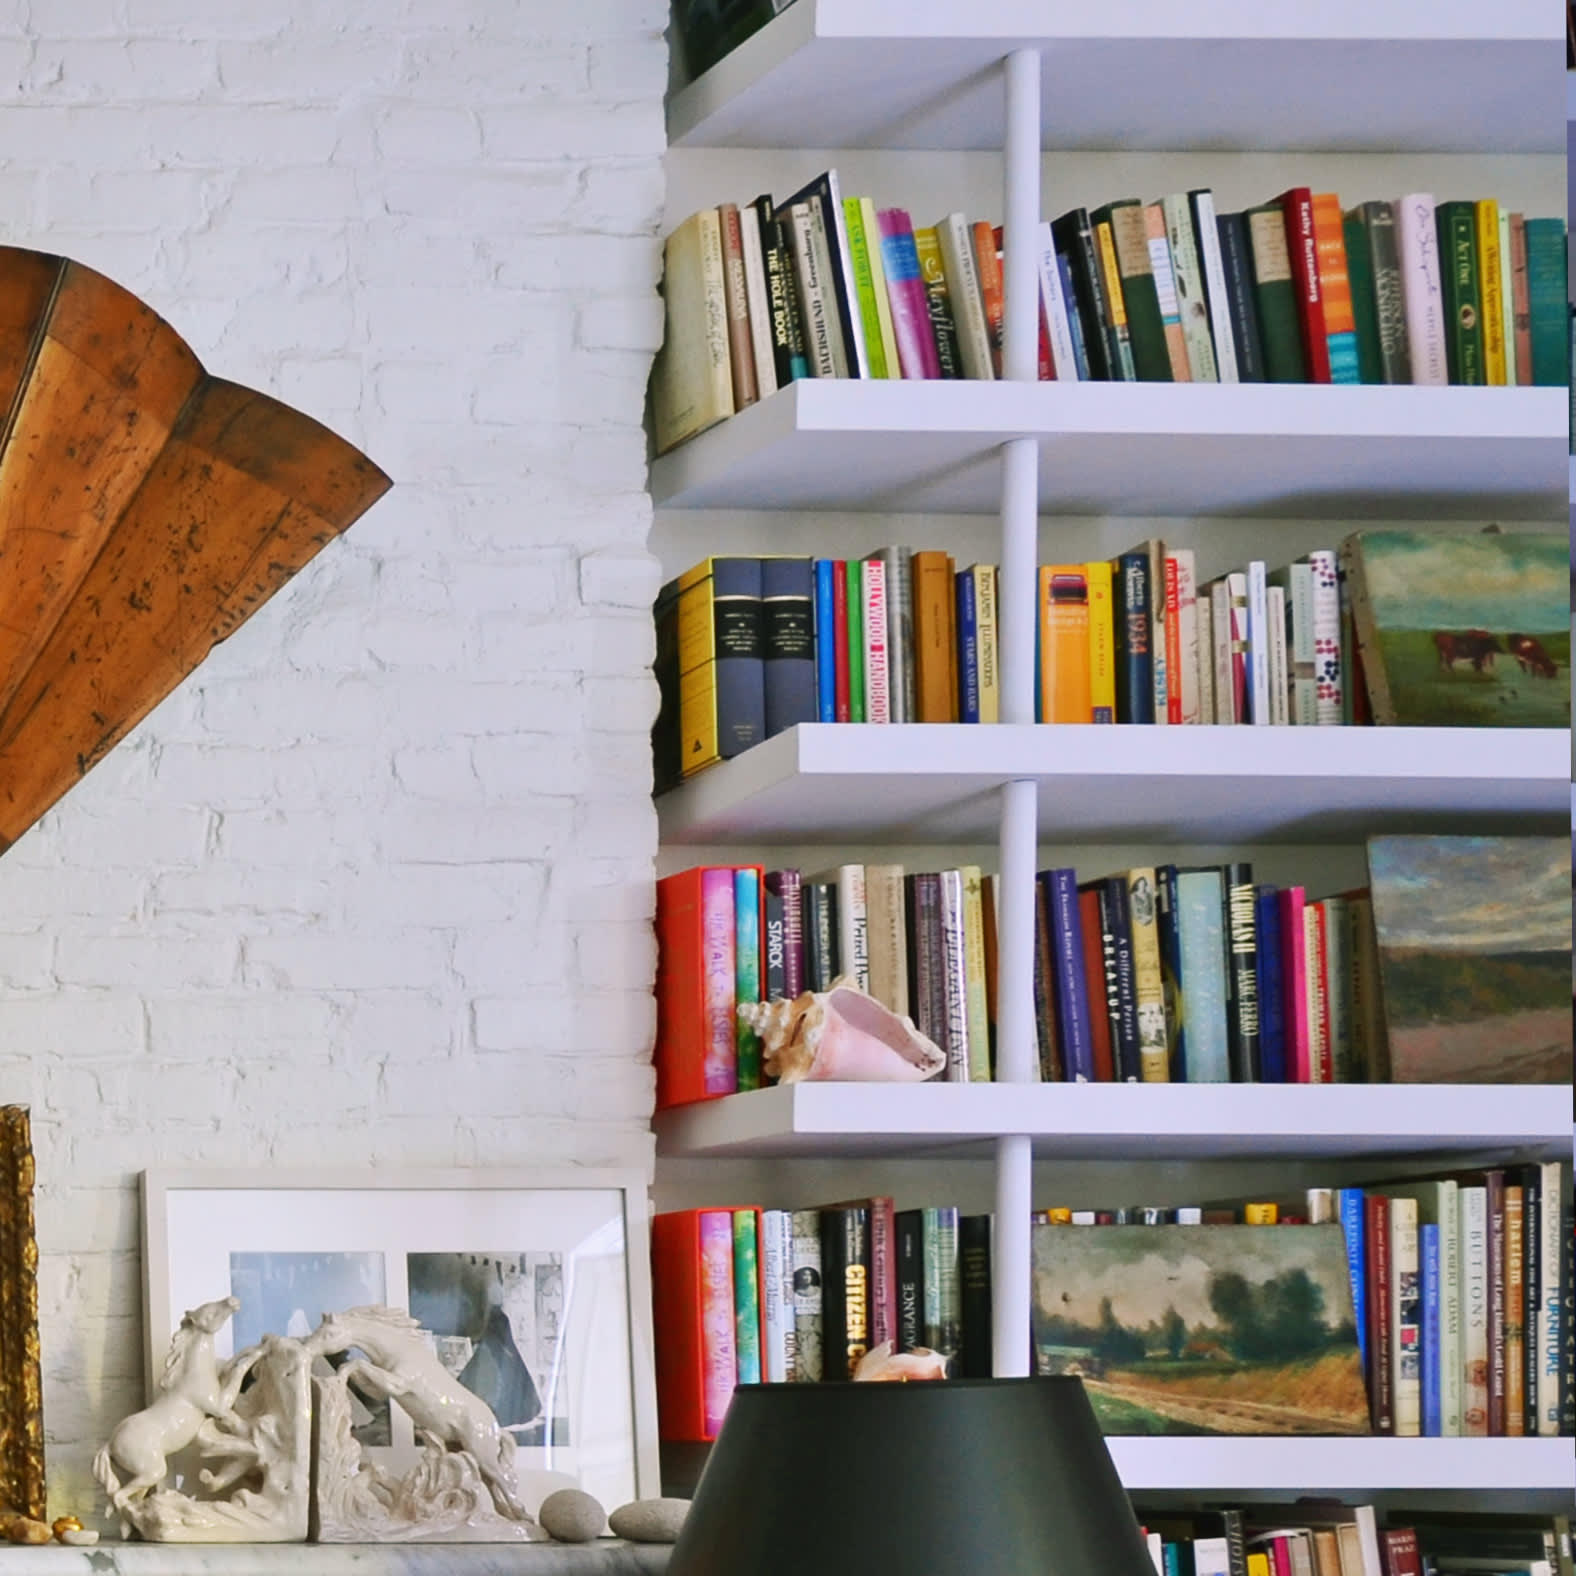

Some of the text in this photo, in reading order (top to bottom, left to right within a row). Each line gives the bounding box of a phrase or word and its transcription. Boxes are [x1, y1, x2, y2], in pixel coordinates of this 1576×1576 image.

[1300, 202, 1319, 302] Kathy Ruttenberg
[767, 248, 787, 346] THE HOLE BOOK
[924, 258, 954, 373] Mayflower
[868, 566, 883, 644] HOLLYWOOD
[1128, 611, 1147, 654] 1934
[768, 920, 782, 968] STARCK
[1229, 884, 1256, 941] NICHOLAS
[1102, 934, 1120, 1020] BREAKUP
[1238, 969, 1257, 998] MARC
[1240, 1001, 1259, 1036] FERRO
[845, 1264, 867, 1339] CITIZEN
[1471, 1231, 1484, 1328] BUTTONS
[1546, 1287, 1559, 1376] FURNITURE
